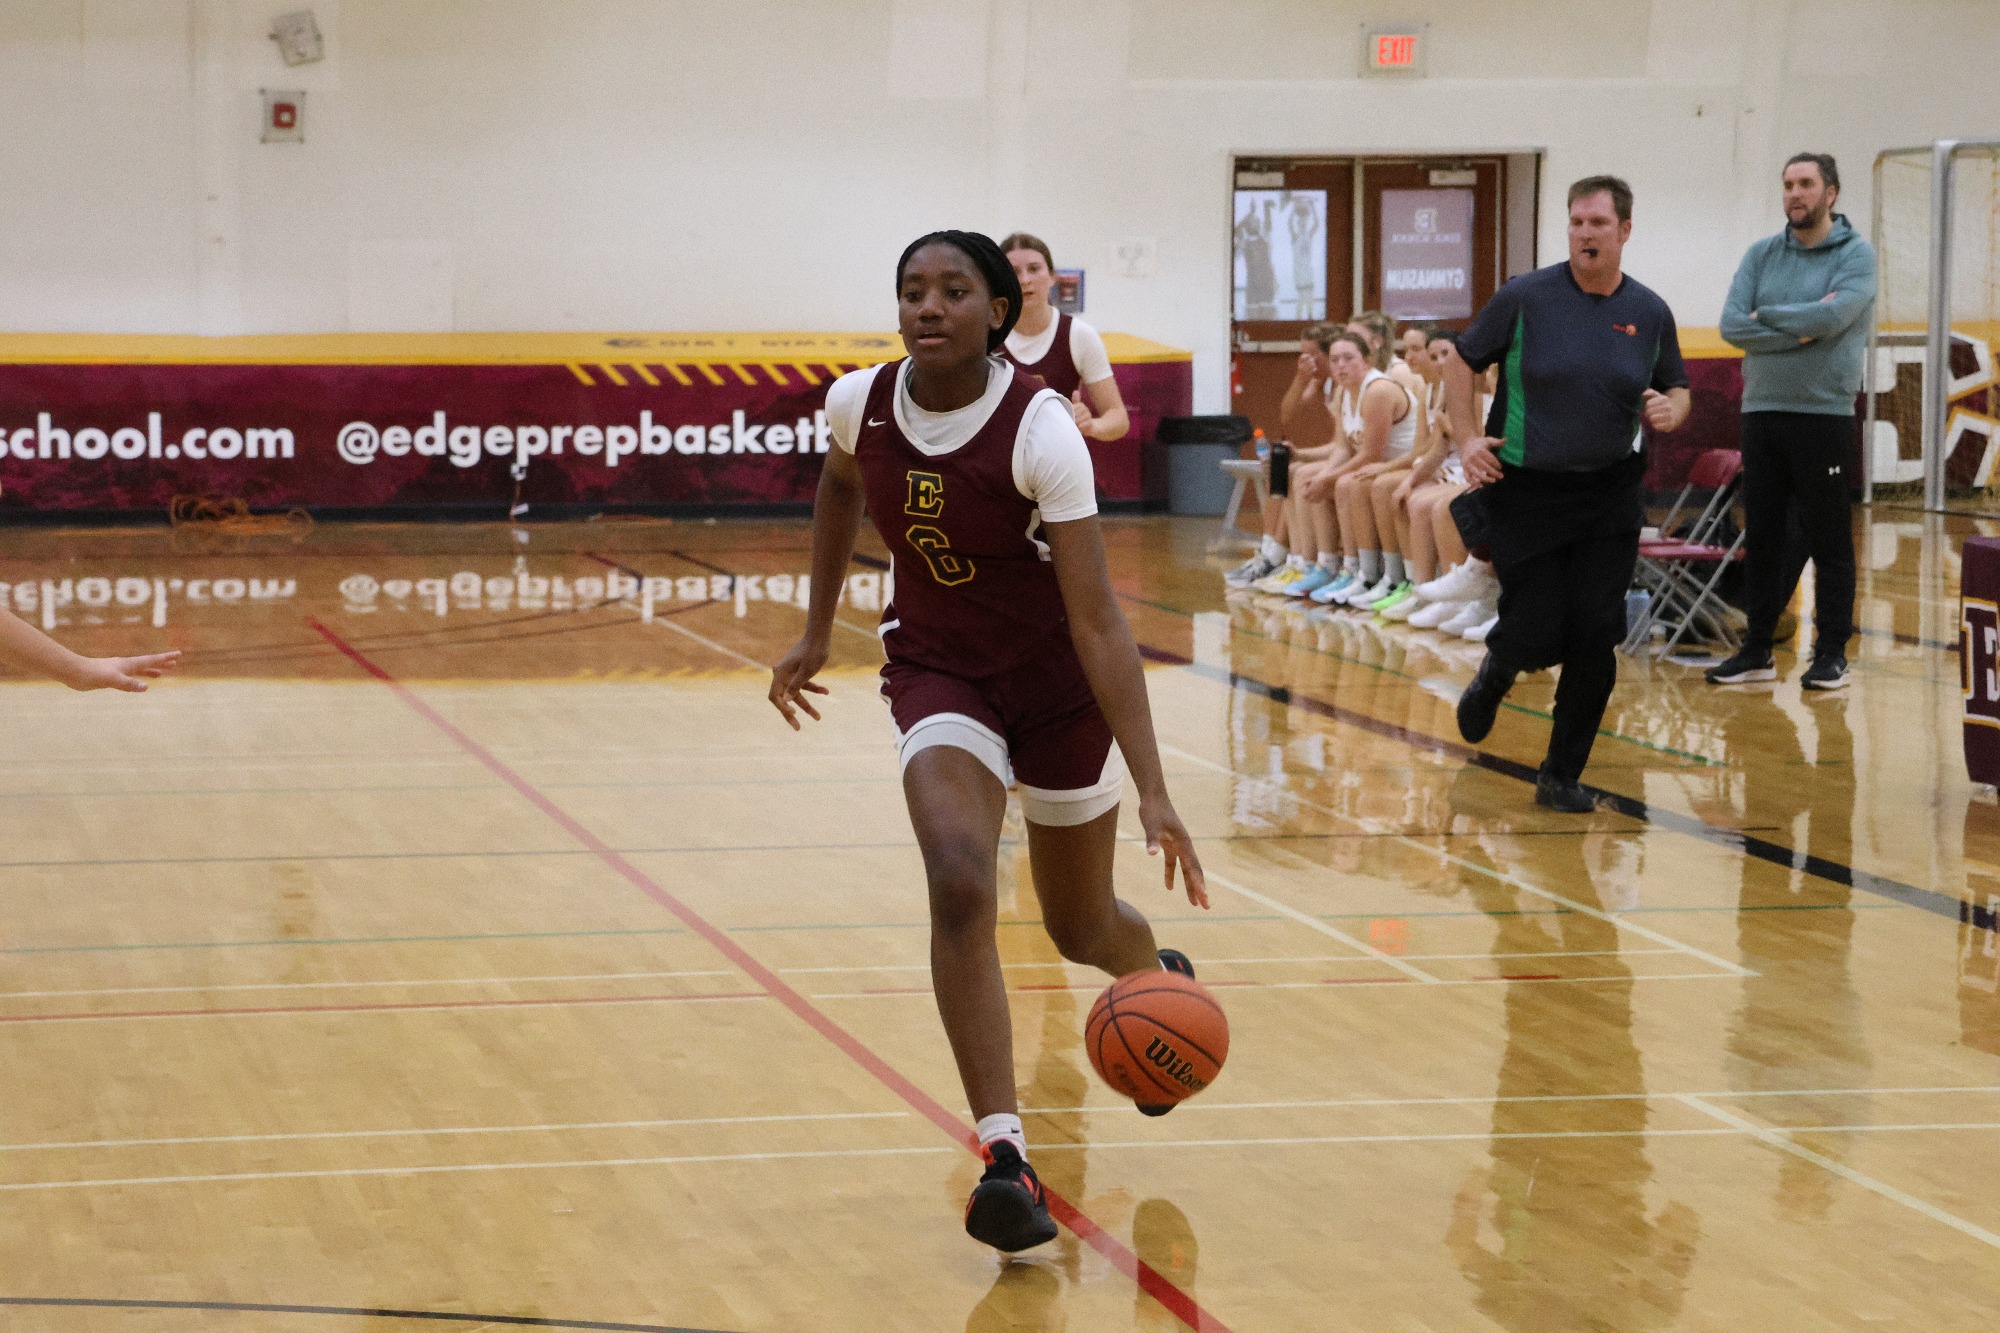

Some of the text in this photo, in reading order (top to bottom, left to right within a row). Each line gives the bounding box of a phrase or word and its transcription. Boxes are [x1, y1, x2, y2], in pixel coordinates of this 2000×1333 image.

[1377, 35, 1417, 65] EXIT
[904, 470, 945, 518] E
[906, 524, 976, 586] 6
